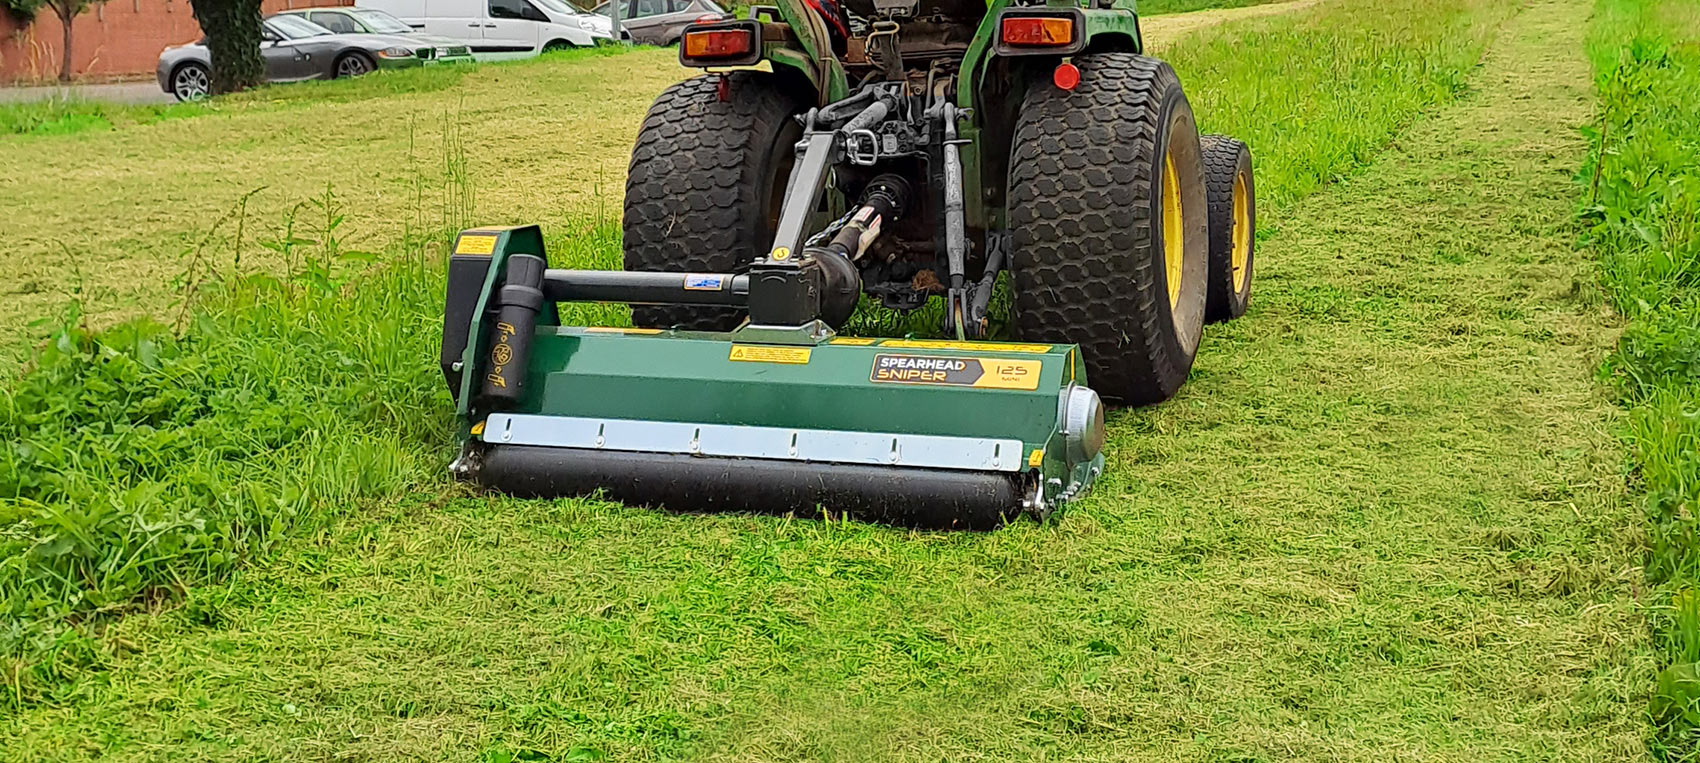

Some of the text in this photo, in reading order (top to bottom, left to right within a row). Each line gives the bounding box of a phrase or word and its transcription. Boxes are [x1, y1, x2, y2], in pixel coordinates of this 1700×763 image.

[880, 358, 966, 371] SPEARHEAD
[996, 365, 1028, 375] 125
[877, 368, 947, 381] SNIPER
